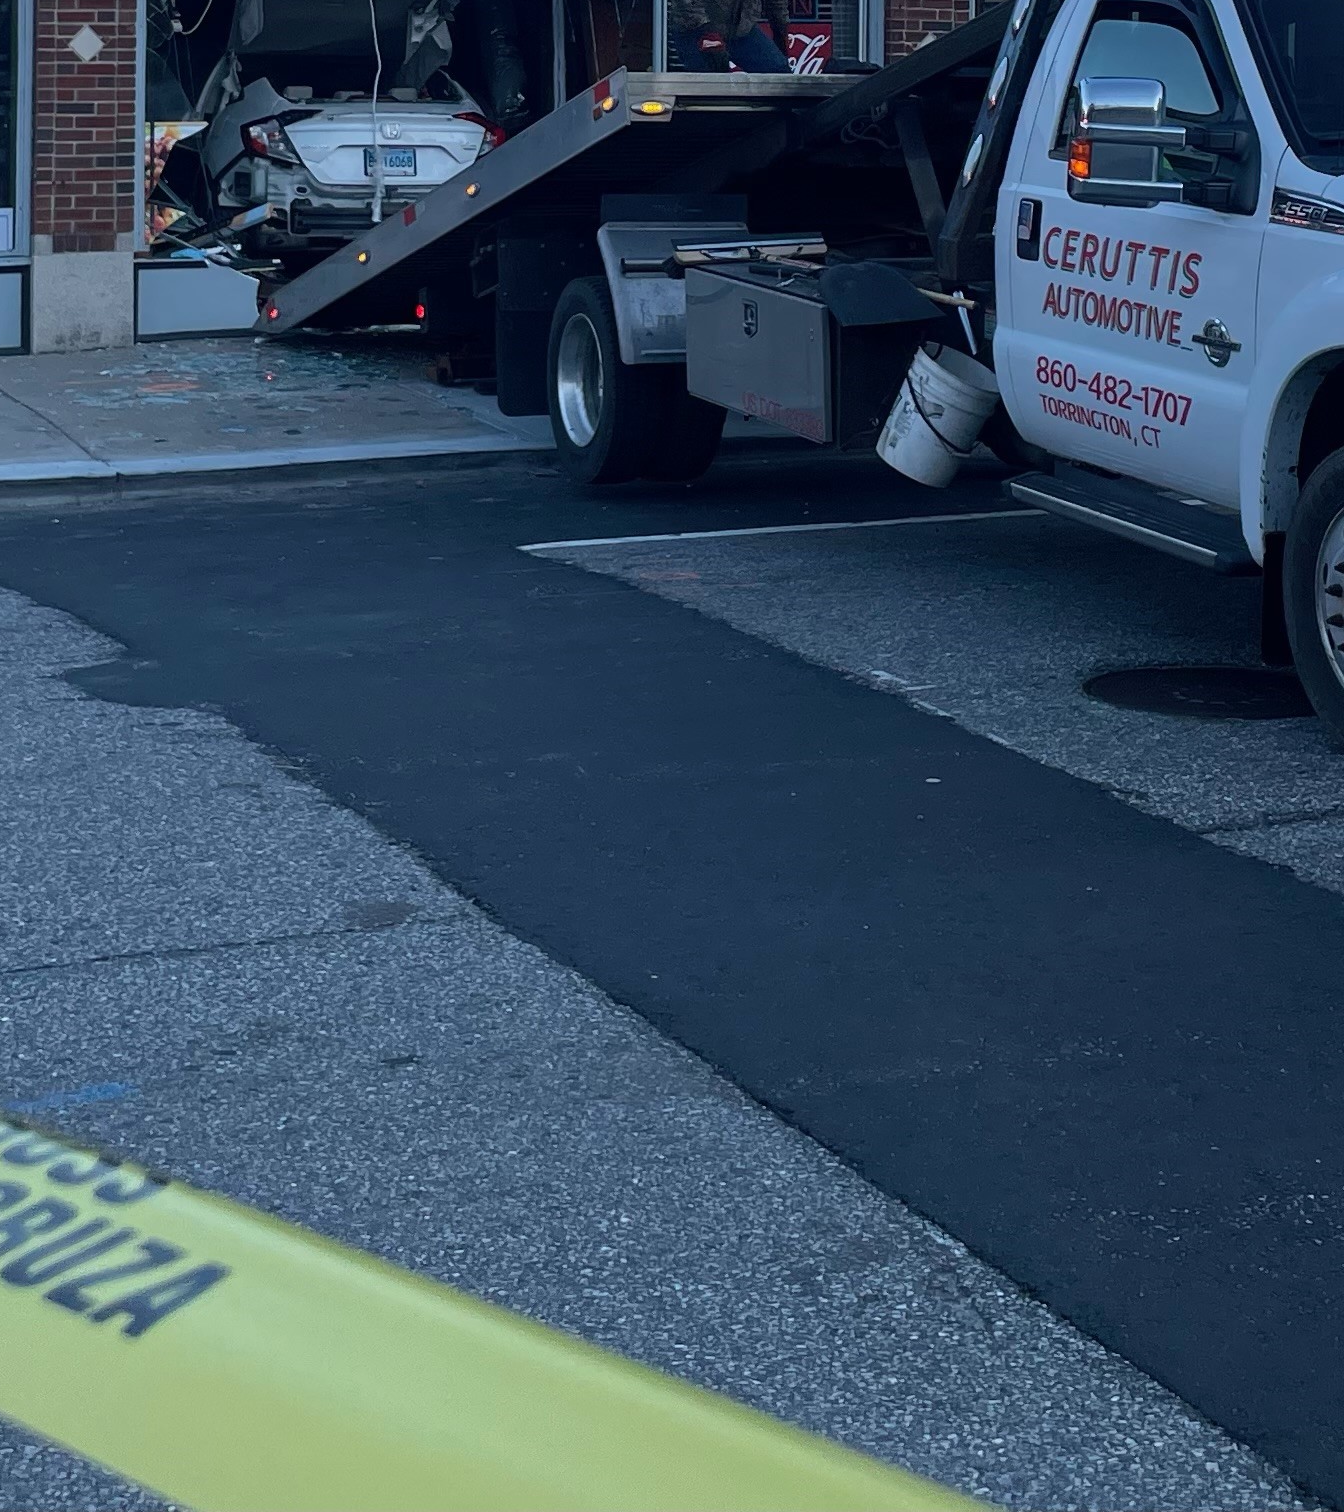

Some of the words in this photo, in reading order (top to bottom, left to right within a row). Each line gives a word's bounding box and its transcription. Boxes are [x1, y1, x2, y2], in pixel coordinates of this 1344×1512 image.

[1043, 226, 1203, 299] CERUTTIS
[1042, 282, 1184, 347] AUTOMOTIVE
[1036, 356, 1193, 427] 860-482-1707
[1141, 425, 1161, 449] CT
